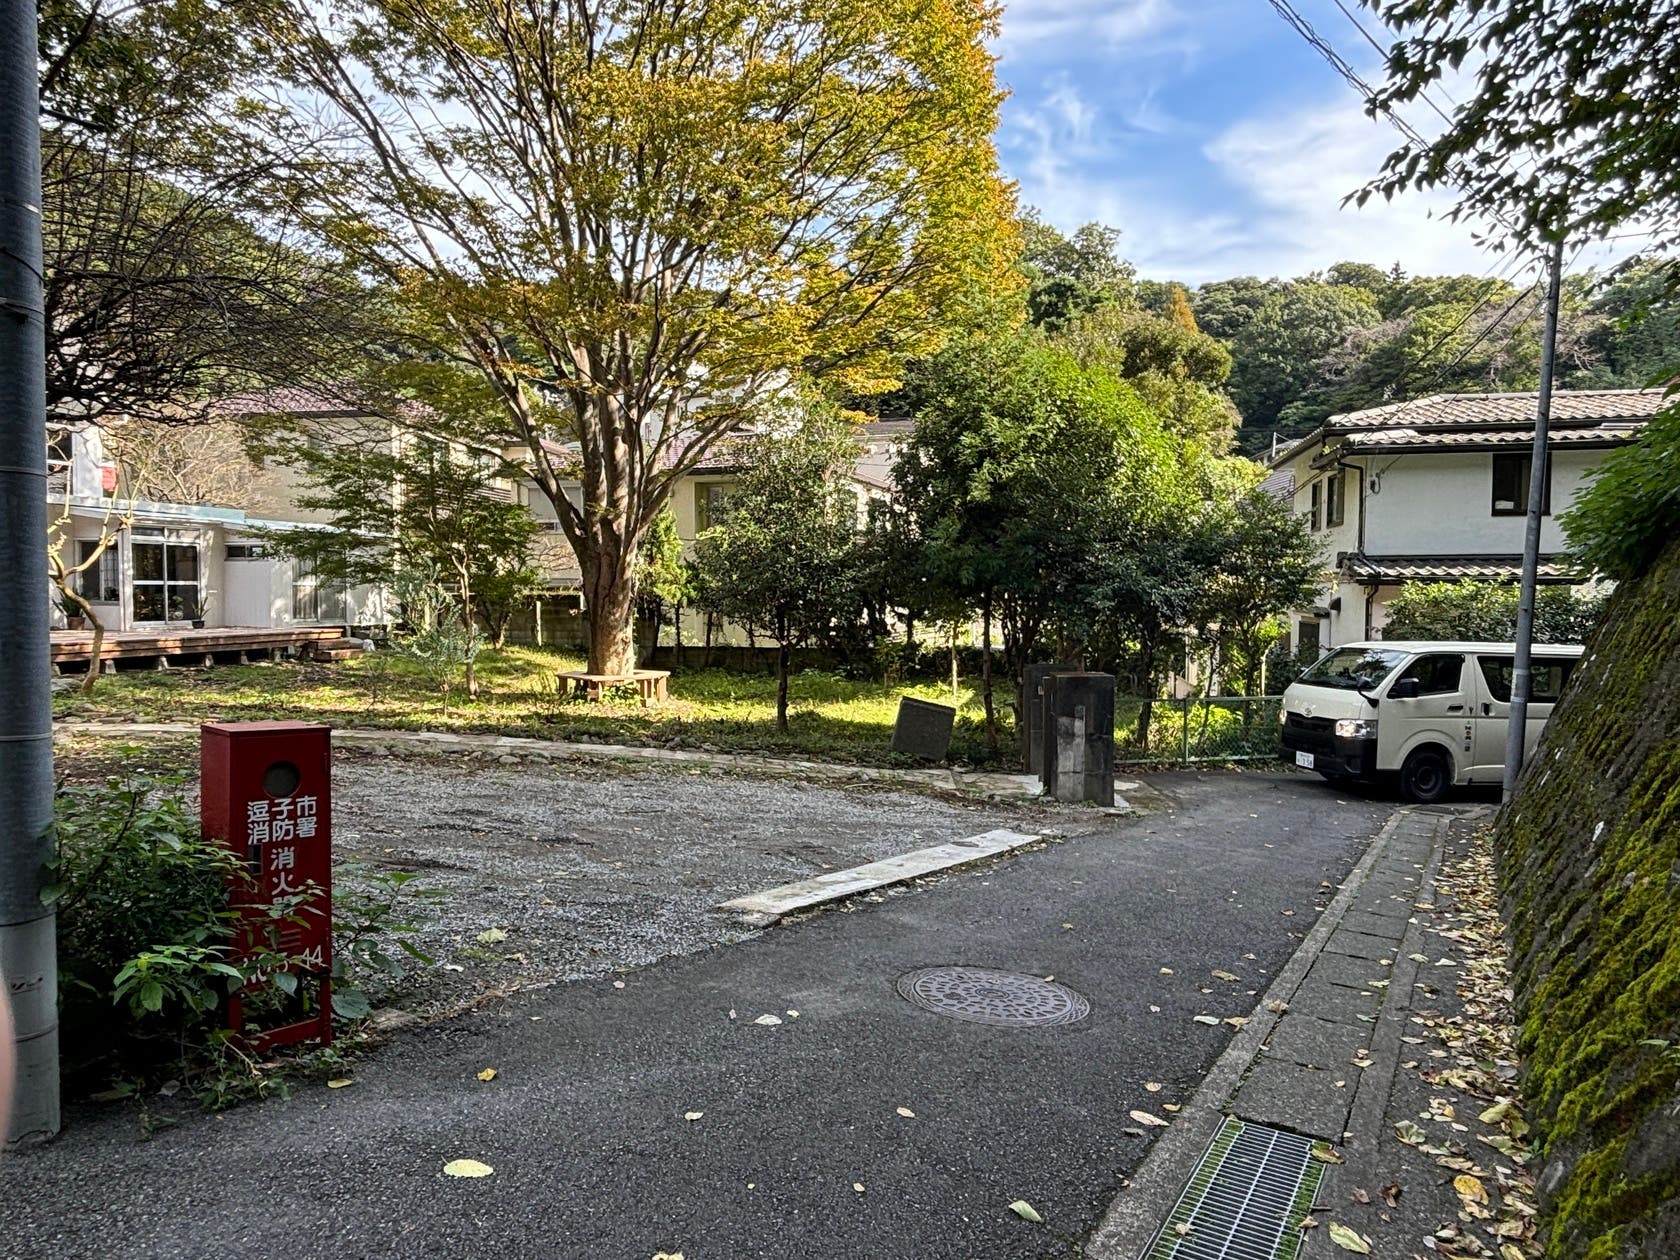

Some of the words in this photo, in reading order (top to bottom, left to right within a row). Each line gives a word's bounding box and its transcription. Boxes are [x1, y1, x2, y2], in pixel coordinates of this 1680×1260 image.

[247, 795, 318, 823] 逗子市
[247, 816, 318, 846] 消防署
